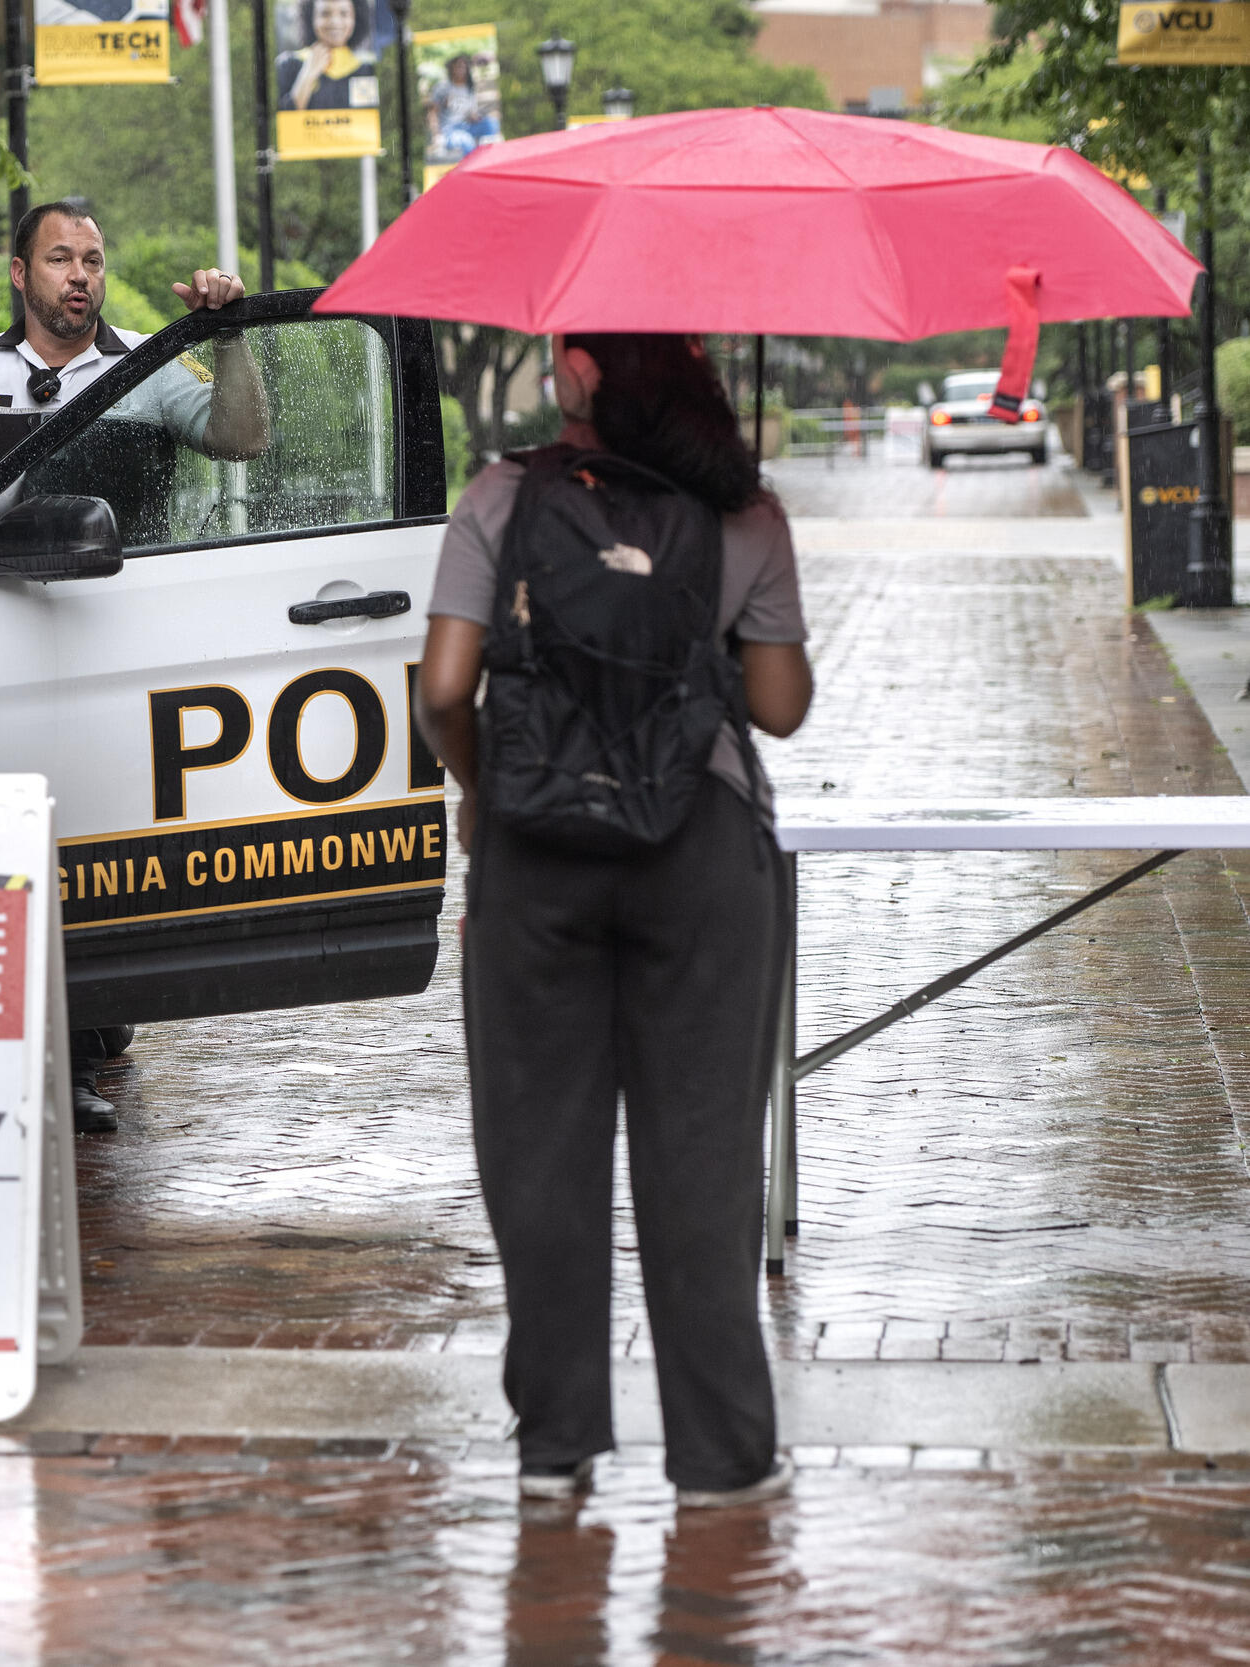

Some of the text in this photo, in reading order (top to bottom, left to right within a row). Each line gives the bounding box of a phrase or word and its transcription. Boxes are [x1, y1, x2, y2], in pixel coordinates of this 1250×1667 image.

[1159, 10, 1214, 30] VCU
[1157, 486, 1200, 504] VCU
[186, 823, 442, 887] COMMONWE
